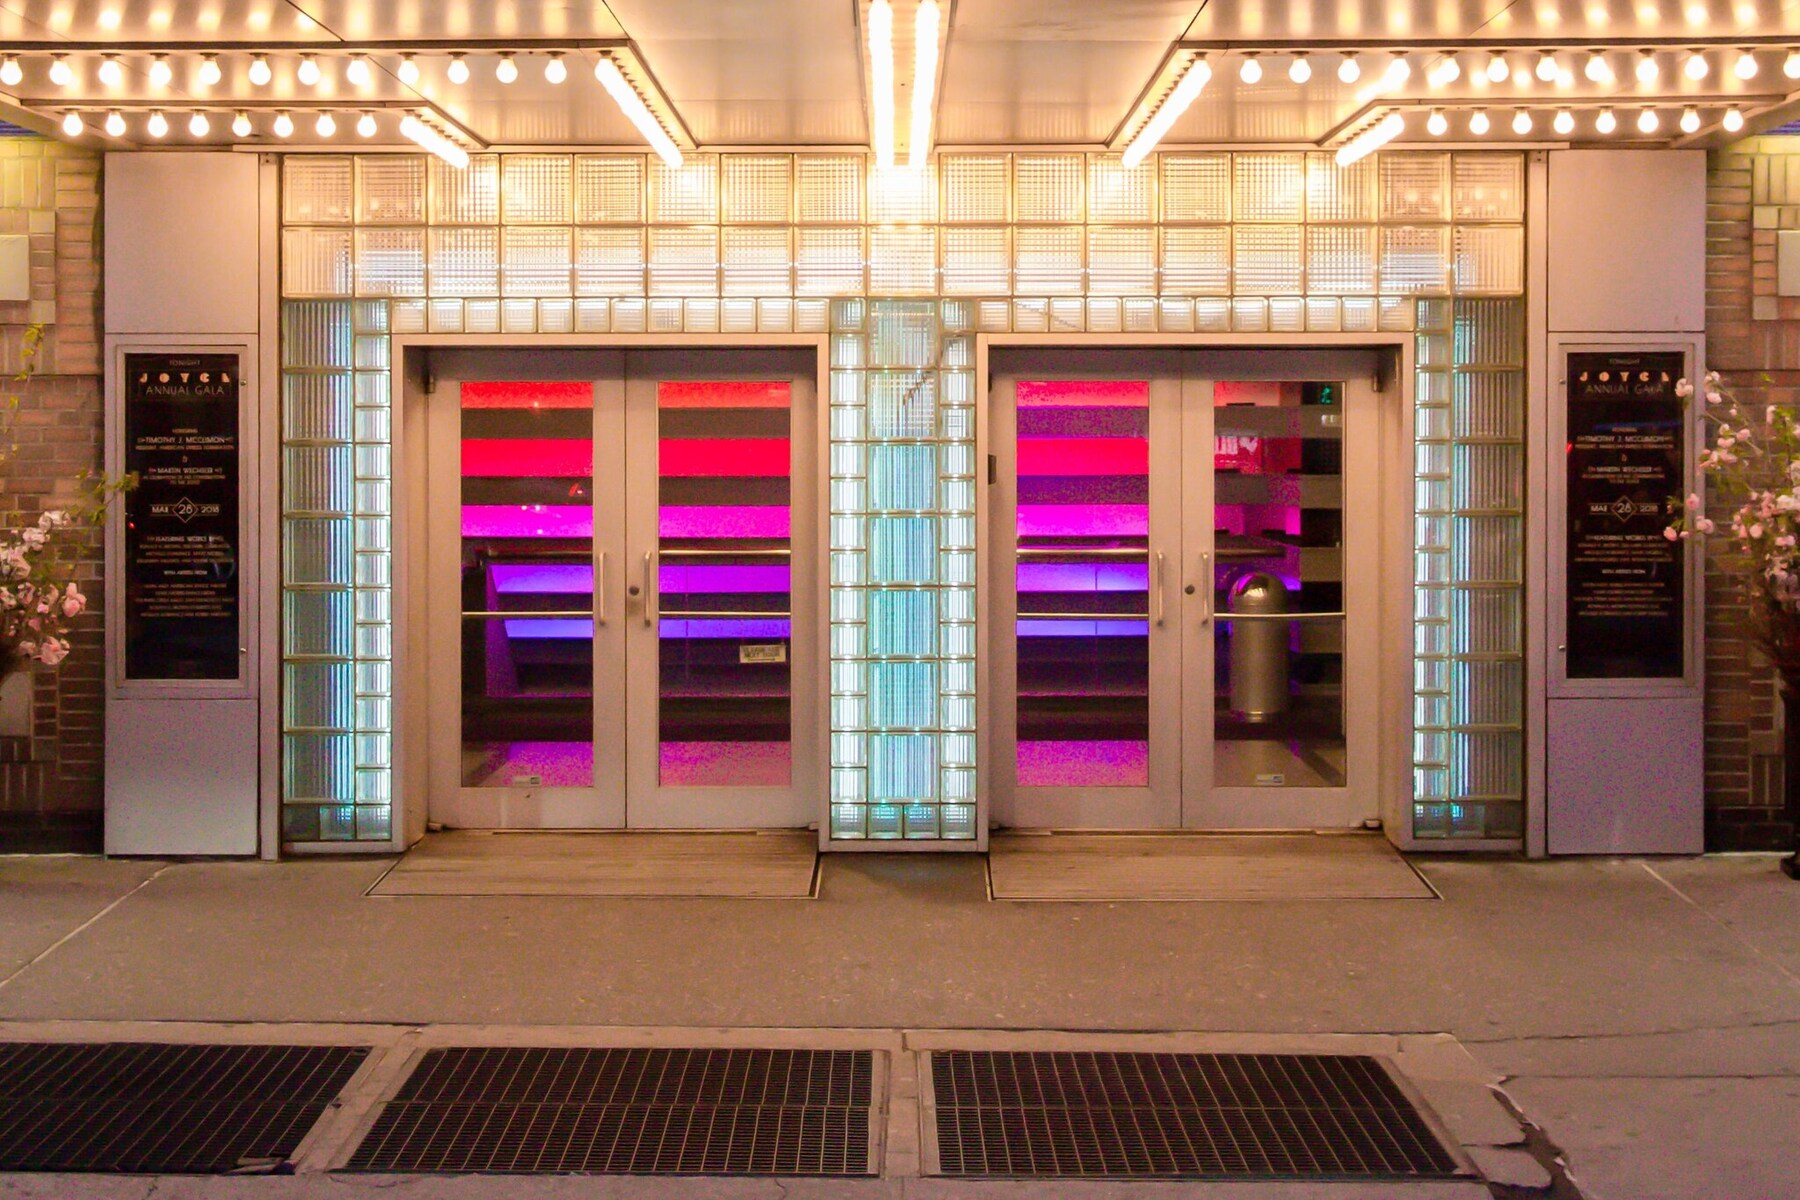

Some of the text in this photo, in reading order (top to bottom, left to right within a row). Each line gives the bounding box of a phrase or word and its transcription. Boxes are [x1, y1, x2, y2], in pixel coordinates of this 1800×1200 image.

[146, 386, 224, 395] ANNUAL GALA
[1585, 385, 1628, 393] ANNUAL
